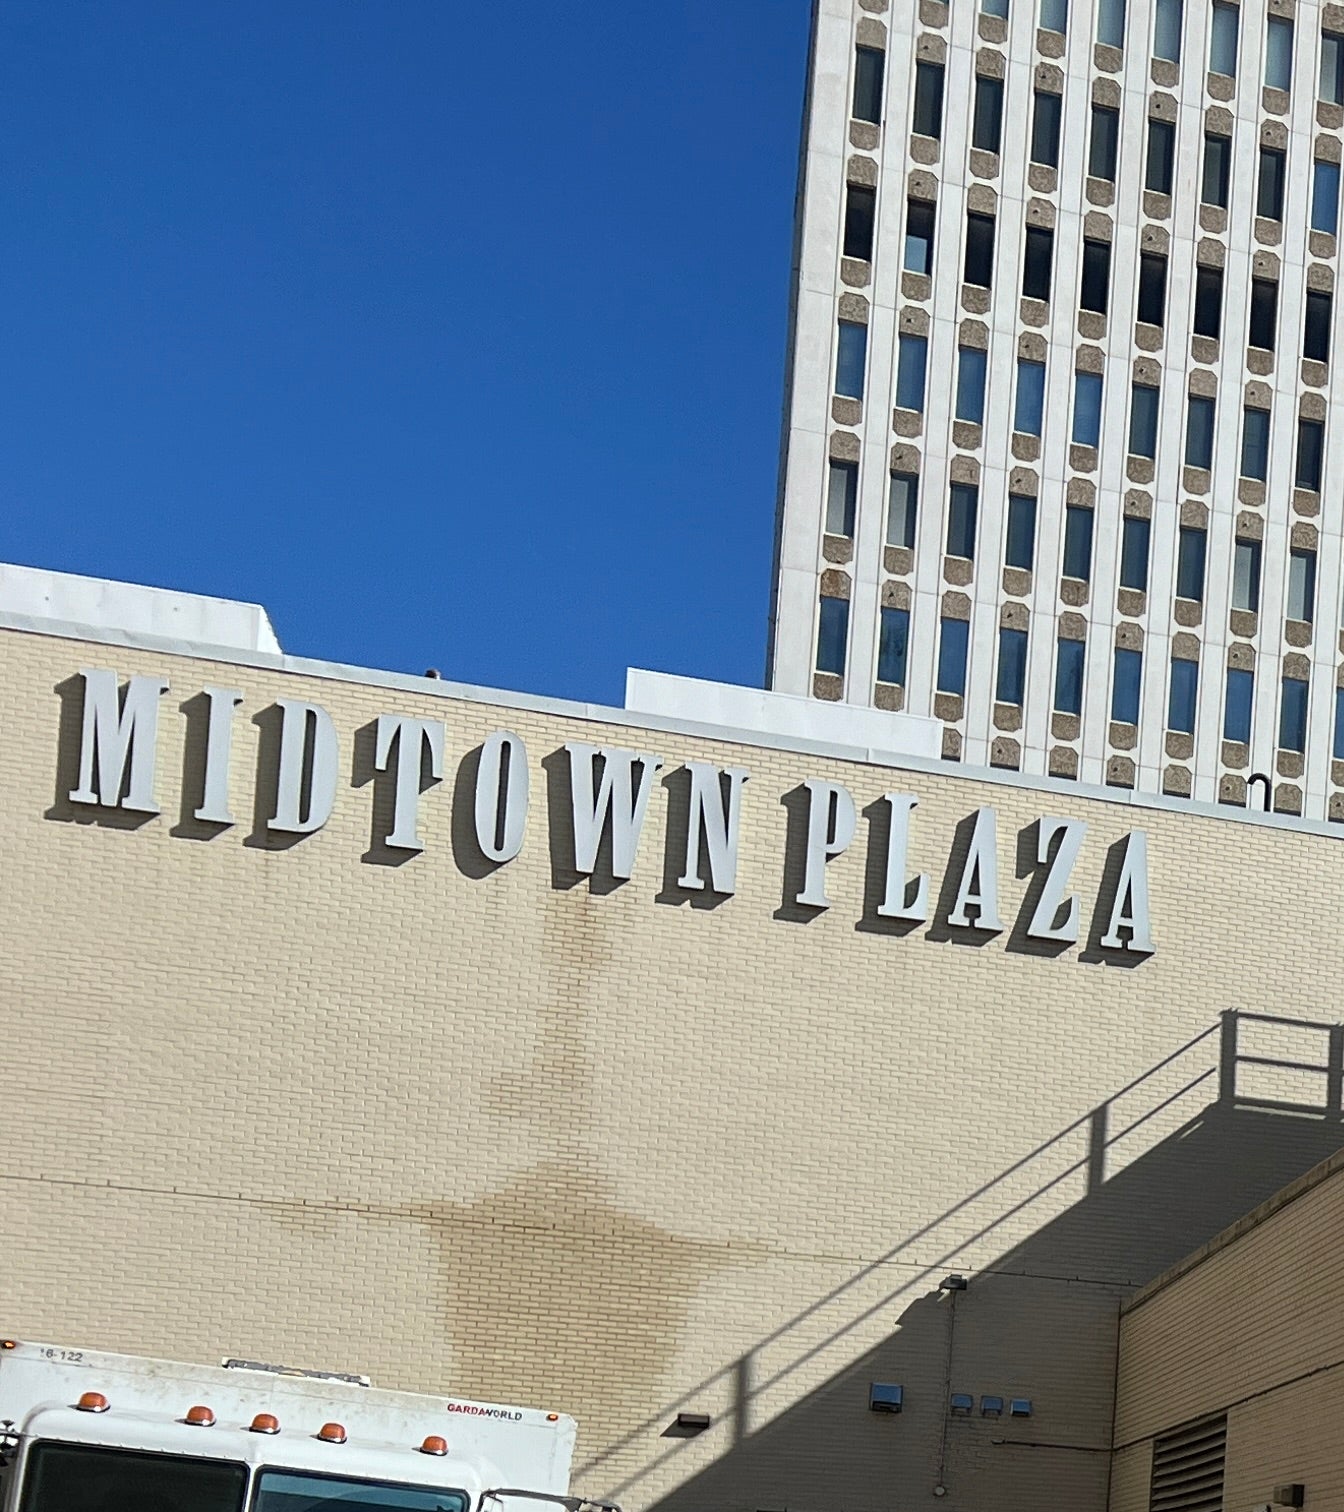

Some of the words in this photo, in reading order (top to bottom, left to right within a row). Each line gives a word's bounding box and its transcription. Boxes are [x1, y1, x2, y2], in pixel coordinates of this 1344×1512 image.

[68, 668, 749, 894] MIDTOWN
[796, 779, 1156, 954] PLAZA
[447, 1403, 523, 1421] GARDAWORLD
